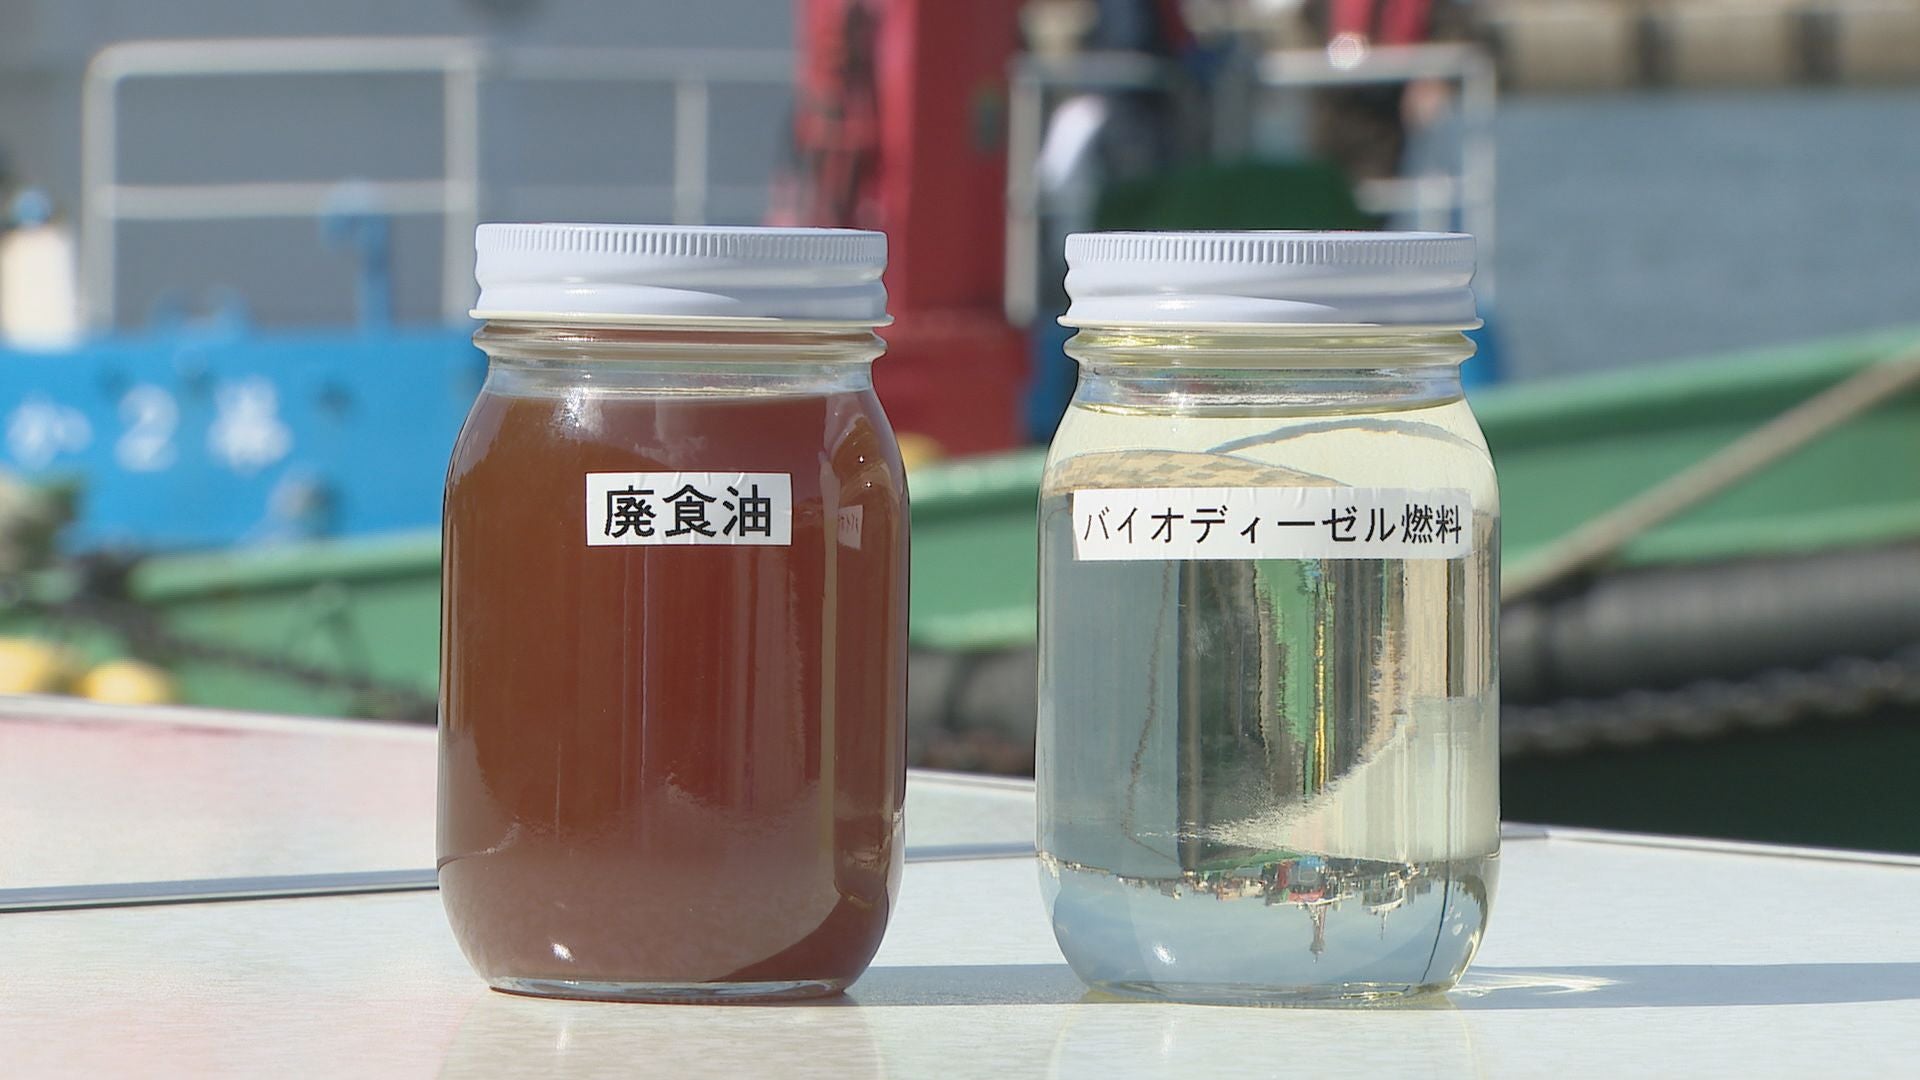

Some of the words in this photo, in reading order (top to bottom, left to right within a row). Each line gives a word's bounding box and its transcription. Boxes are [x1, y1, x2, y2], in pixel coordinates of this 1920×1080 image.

[604, 484, 771, 538] 廃食油
[1084, 503, 1462, 544] バイオディーゼル燃料
